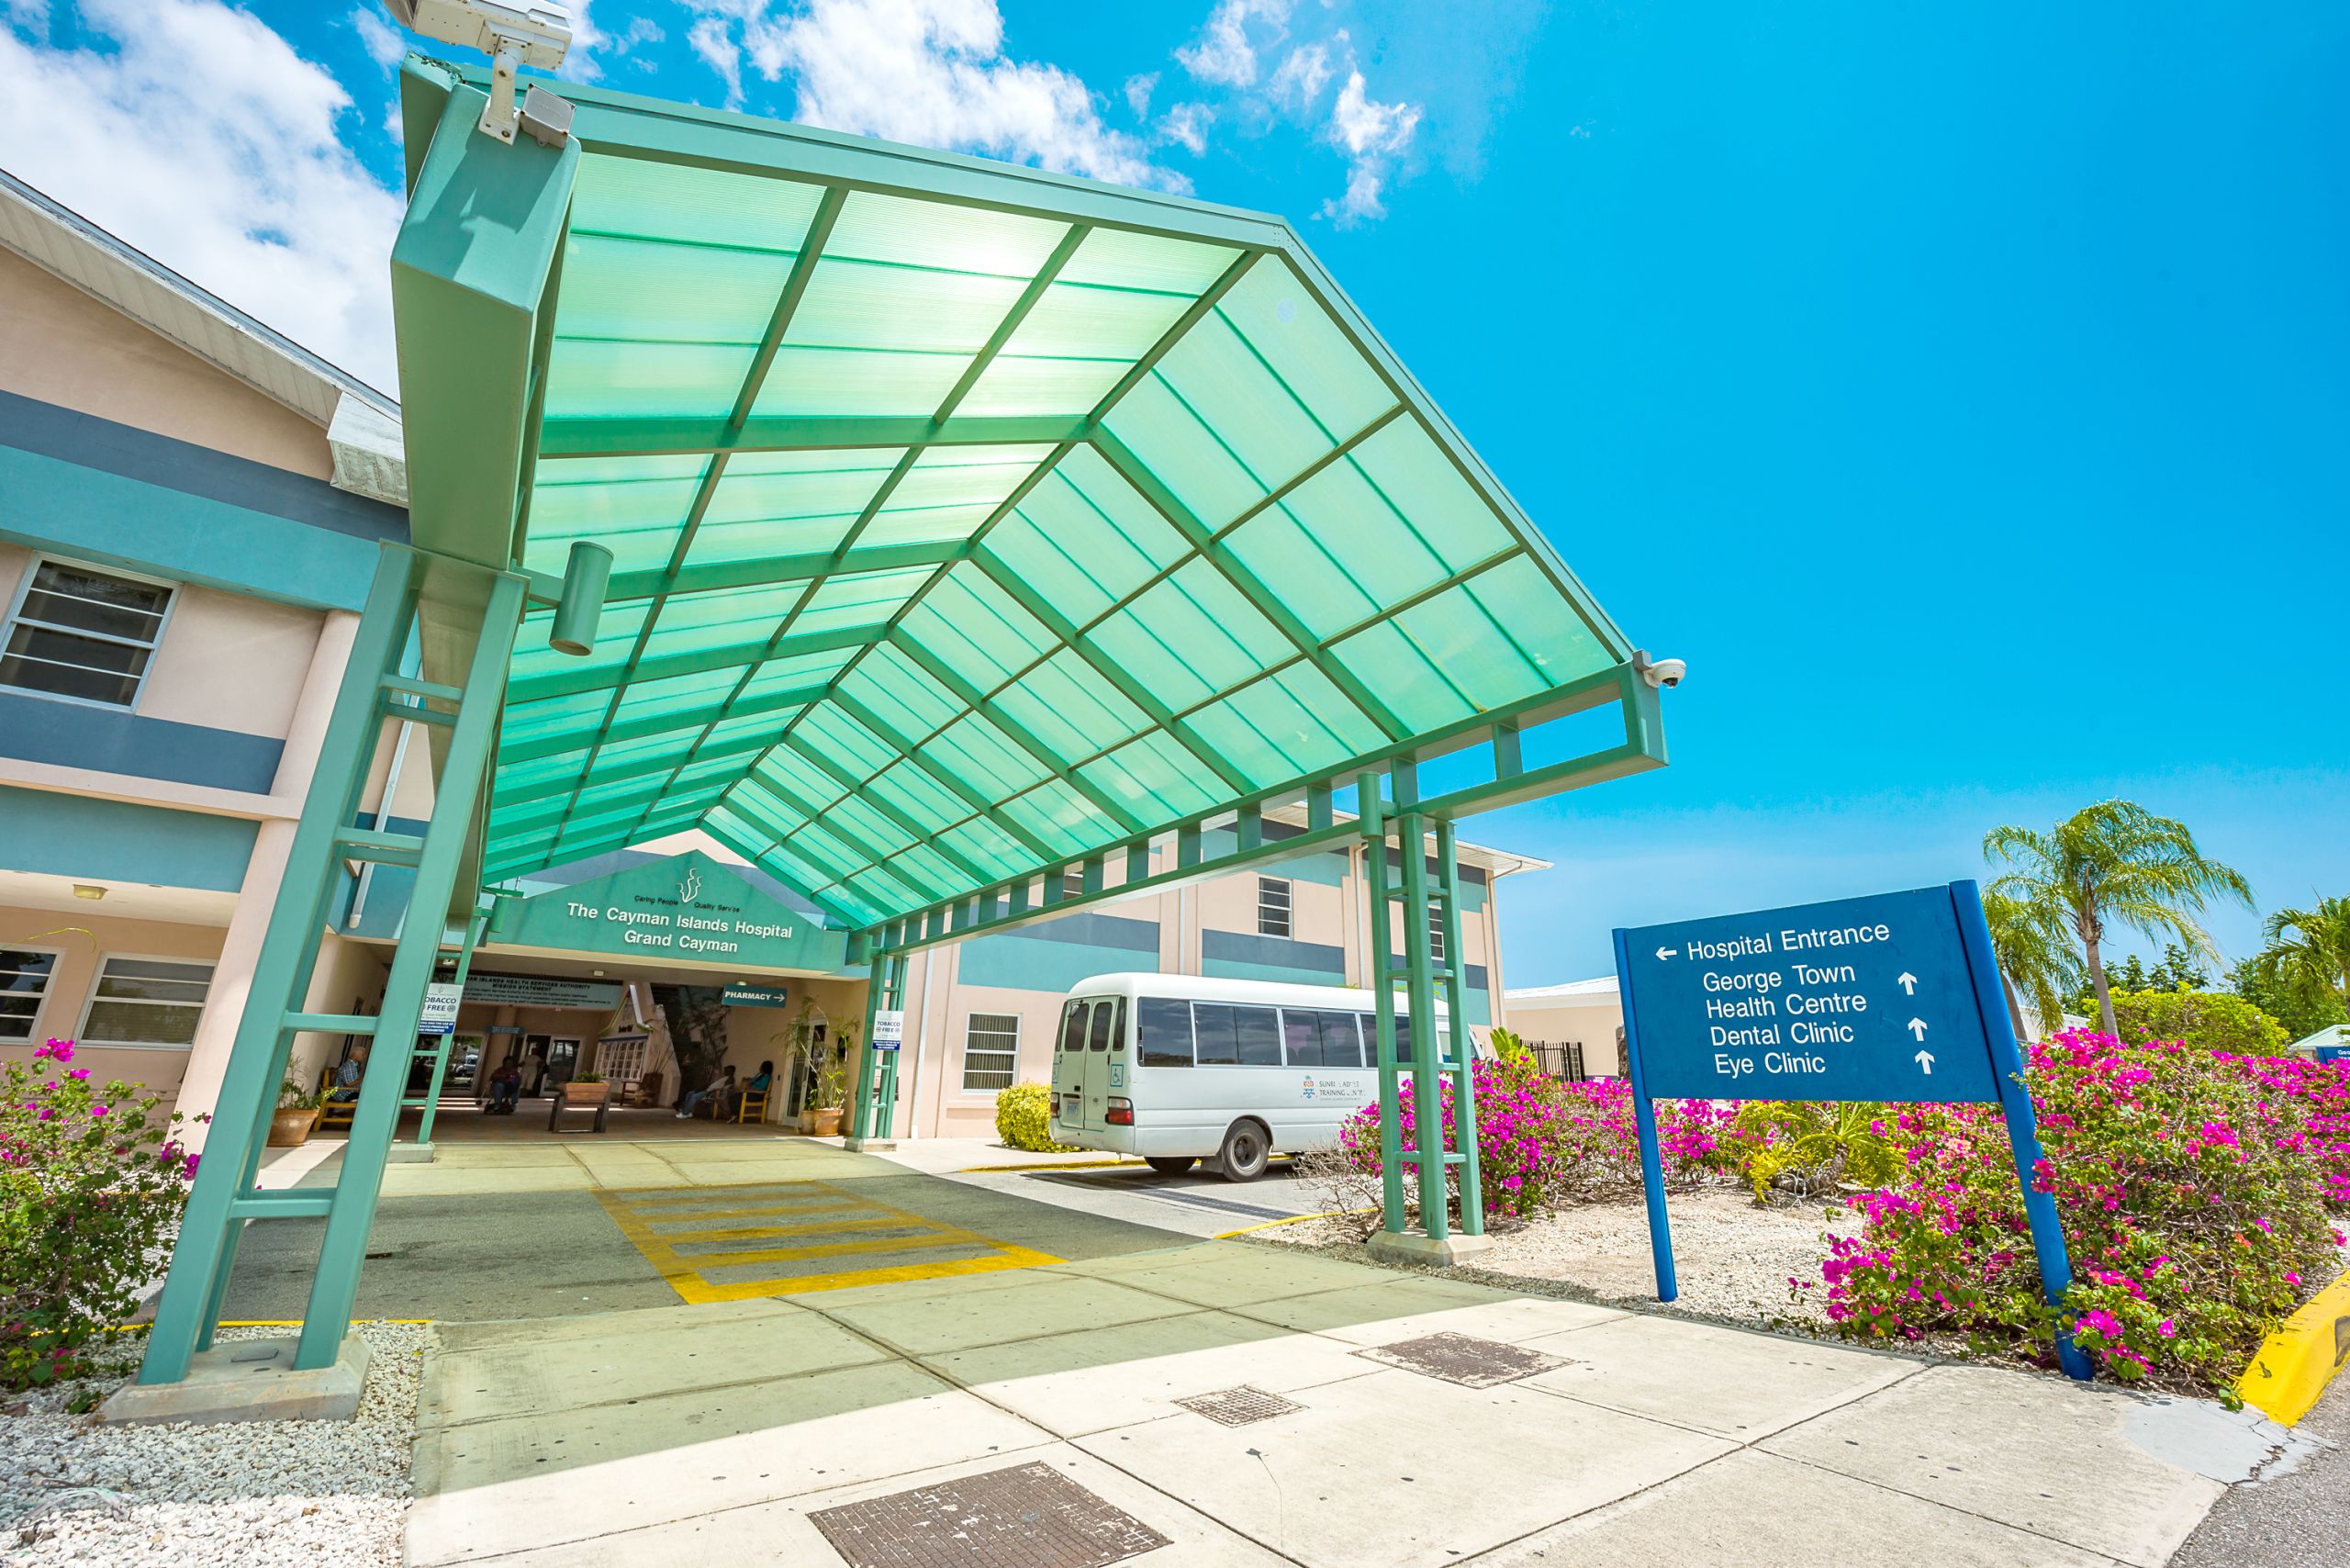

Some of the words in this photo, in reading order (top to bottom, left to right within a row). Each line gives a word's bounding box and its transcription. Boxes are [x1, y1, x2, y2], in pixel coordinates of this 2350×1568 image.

[634, 895, 655, 905] Caring
[657, 897, 679, 906] People
[694, 902, 715, 912] Quality
[717, 904, 740, 913] Service
[567, 902, 598, 919] The
[606, 907, 670, 926] Cayman
[677, 914, 729, 932] Islands
[734, 921, 792, 939] Hospital
[624, 929, 672, 947] Grand
[678, 935, 738, 953] Cayman
[1687, 933, 1773, 961] Hospital
[1781, 924, 1890, 951] Entrance
[1703, 971, 1782, 993] George
[1792, 964, 1856, 985] Town
[725, 991, 771, 1001] PHARMACY
[1706, 996, 1776, 1019] Health
[1785, 992, 1867, 1015] Centre
[1710, 1024, 1781, 1046] Dental
[1790, 1021, 1854, 1044] Clinic
[1715, 1054, 1754, 1079] Eye
[1764, 1051, 1826, 1073] Clinic
